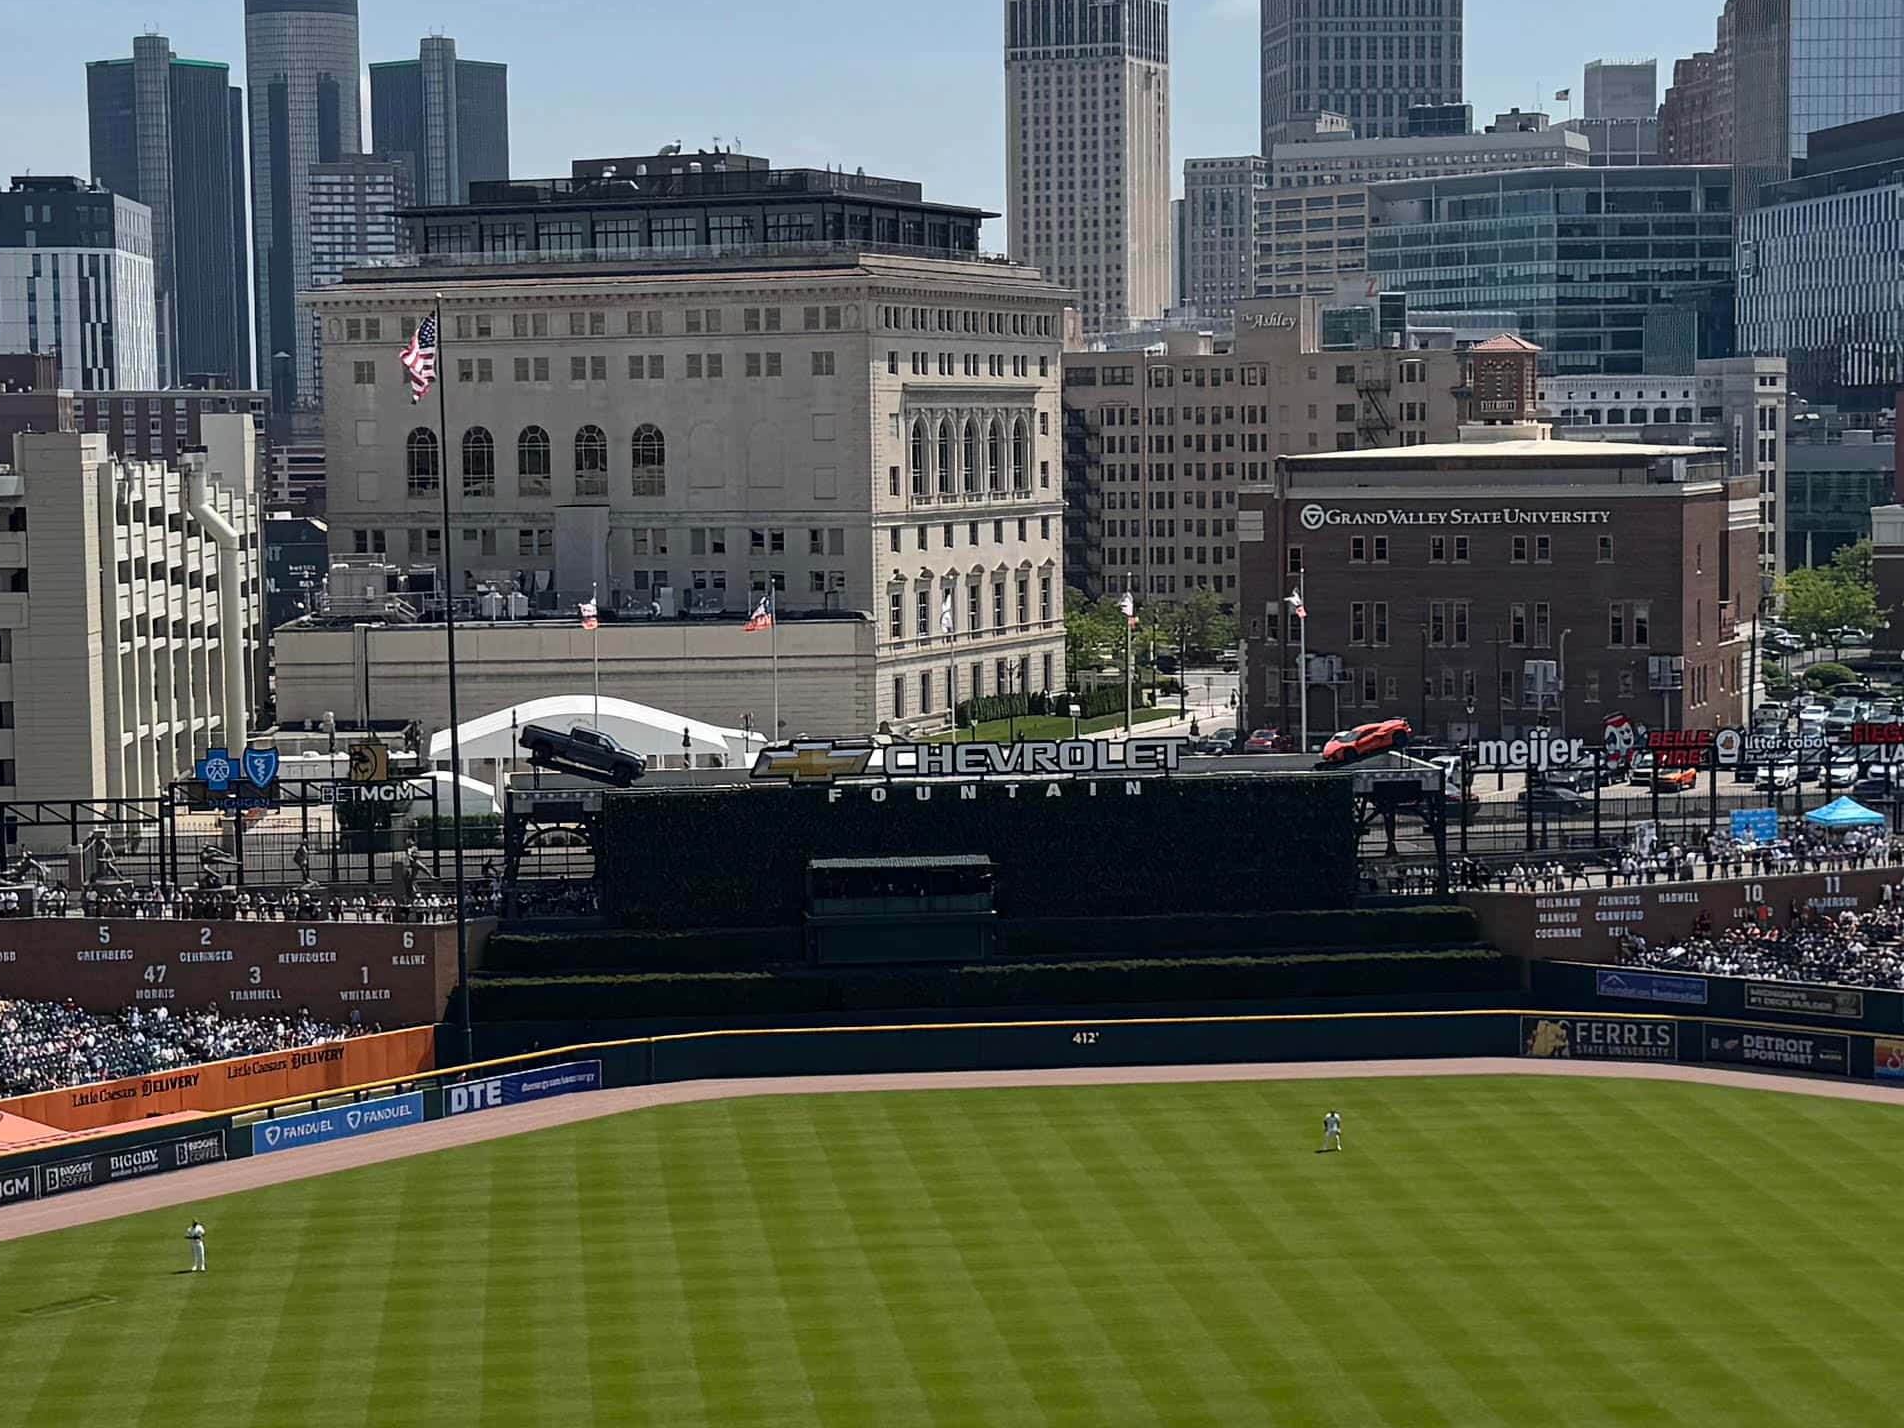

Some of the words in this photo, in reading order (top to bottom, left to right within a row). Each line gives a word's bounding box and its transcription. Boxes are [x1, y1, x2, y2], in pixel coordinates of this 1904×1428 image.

[1250, 312, 1296, 330] Ashley
[1326, 509, 1388, 524] GRAND
[1387, 509, 1447, 524] VALLEY
[1450, 509, 1504, 524] STATE
[1504, 508, 1611, 524] UNIVERSITY
[1650, 731, 1712, 747] BELLE
[884, 738, 1188, 774] CHEVROLET
[1478, 730, 1584, 771] meijer
[321, 784, 414, 803] BETMGM
[829, 781, 1141, 803] FOUNTAIN
[1744, 885, 1763, 903] 10
[99, 926, 110, 945] 5
[200, 927, 211, 945] 2
[297, 928, 316, 947] 16
[403, 931, 414, 949] 6
[144, 964, 166, 983] 47
[250, 966, 261, 984] 3
[360, 967, 369, 983] 1
[1575, 1021, 1671, 1047] FERRIS
[1743, 1034, 1814, 1053] DETROIT
[291, 1046, 345, 1069] DELIVERY
[1608, 1046, 1670, 1058] UNIVERSITY
[1743, 1048, 1814, 1066] SPORTSNET
[142, 1073, 200, 1098] DELIVERY
[451, 1080, 503, 1114] DTE
[283, 1119, 334, 1140] FANDUEL
[363, 1105, 412, 1124] FANDUEL
